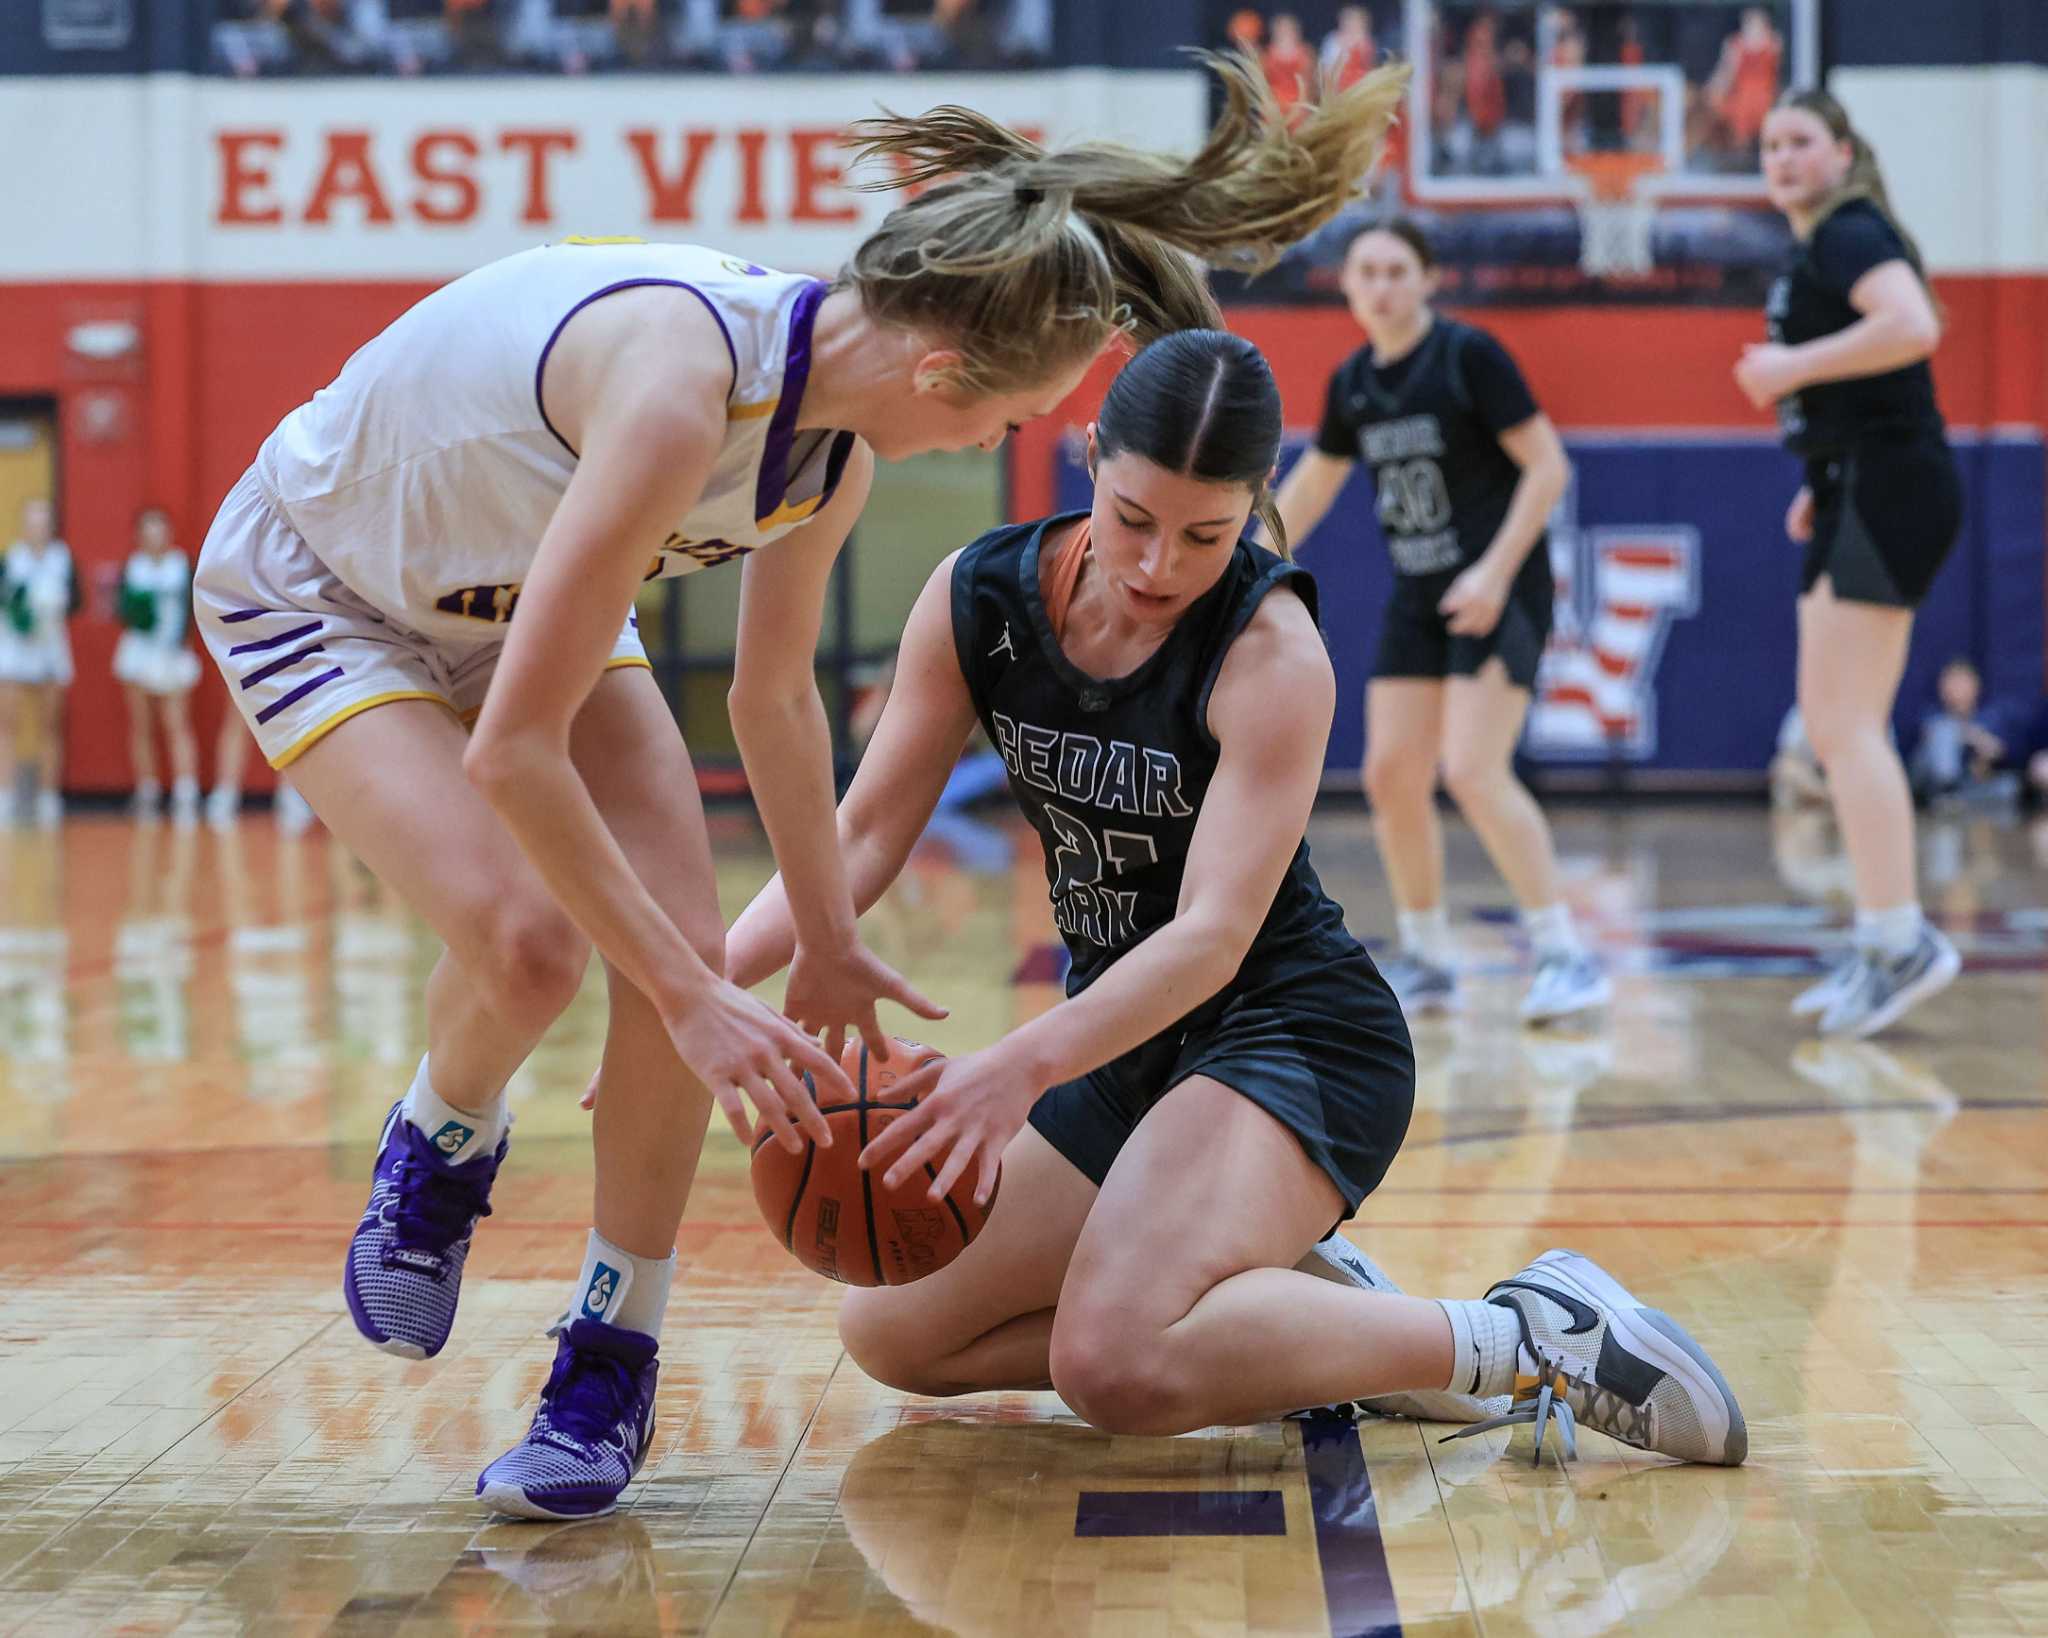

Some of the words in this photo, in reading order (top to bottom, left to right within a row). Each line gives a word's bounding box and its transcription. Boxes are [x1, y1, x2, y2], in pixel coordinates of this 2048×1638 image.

[215, 130, 577, 224] EAST
[624, 128, 1044, 223] VIE
[993, 710, 1194, 817] CEDAR
[1054, 882, 1138, 946] ARK
